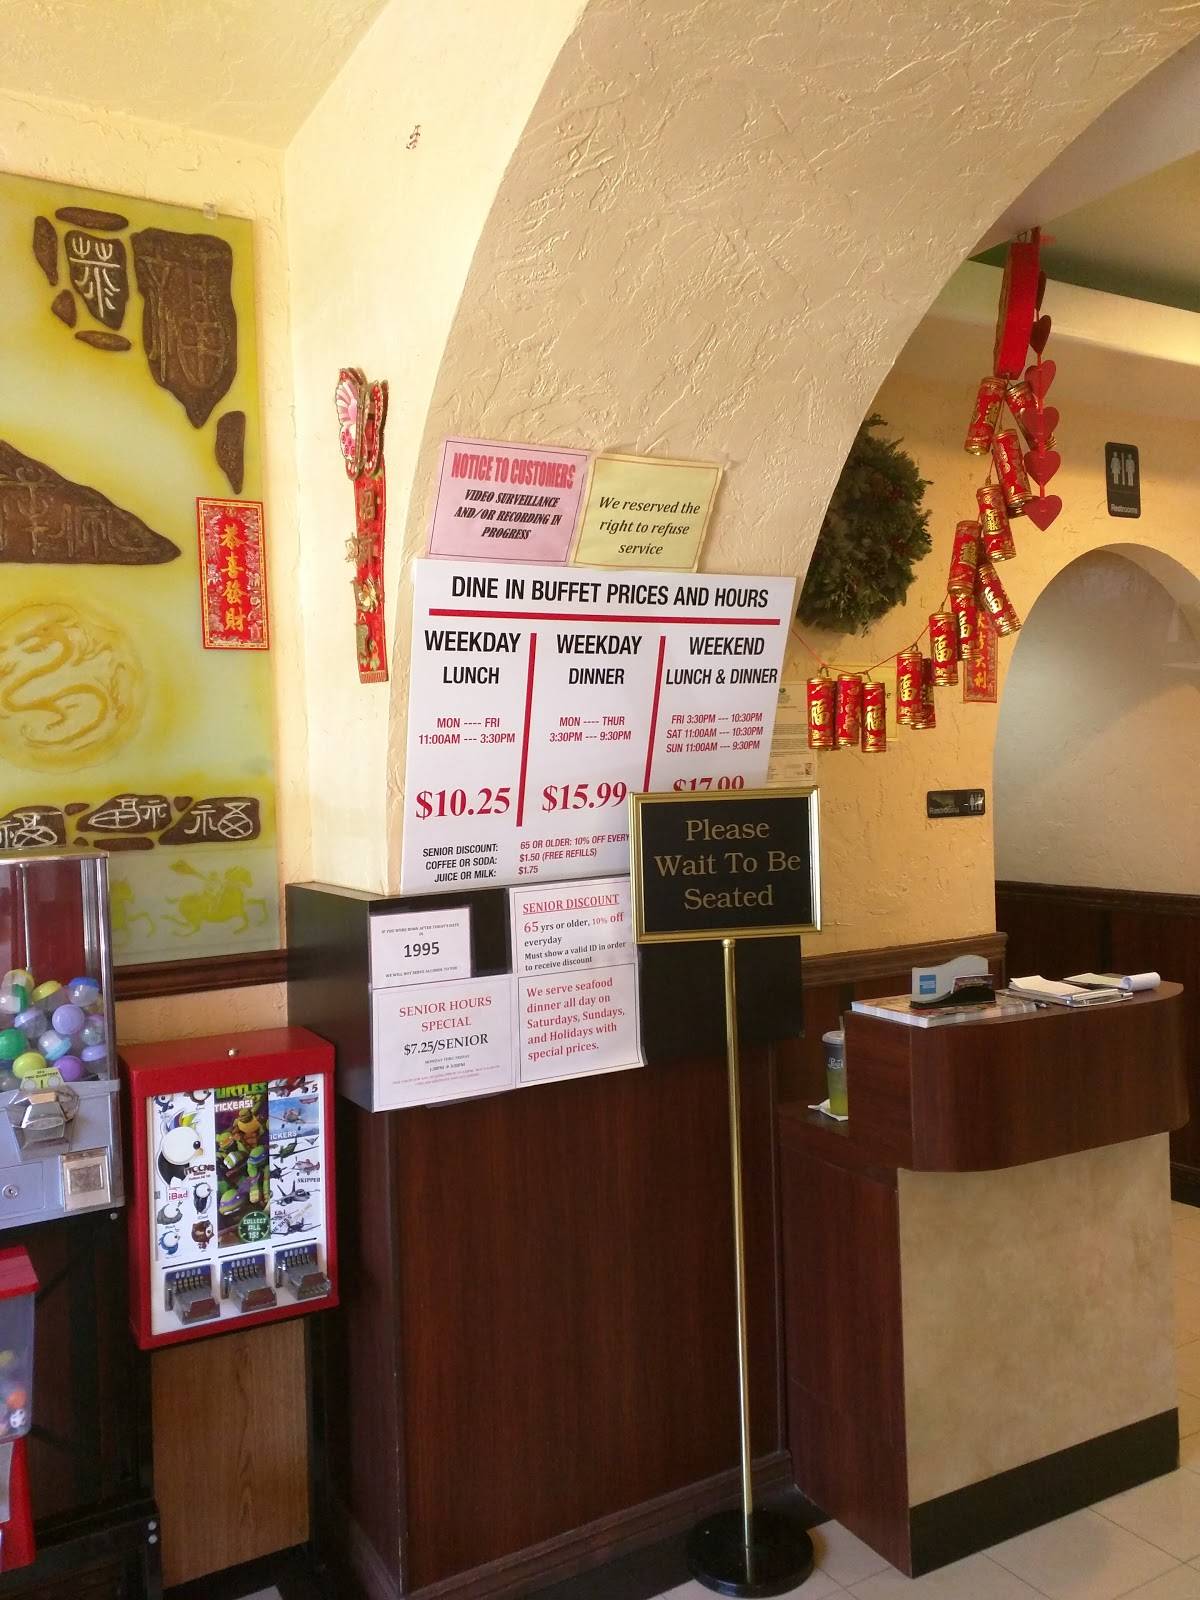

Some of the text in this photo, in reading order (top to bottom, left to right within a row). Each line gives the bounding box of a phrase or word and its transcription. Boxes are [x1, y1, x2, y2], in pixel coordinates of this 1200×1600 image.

[451, 452, 576, 489] NOTICE TO CUSTOMERS
[464, 489, 560, 508] VIDEO SURVEILLANCE
[598, 496, 701, 515] We reserved the
[454, 506, 562, 526] AND/OR RECORDING IN
[481, 526, 531, 540] PROGRESS
[599, 519, 690, 537] right to refuse
[618, 543, 664, 555] service
[452, 576, 768, 607] DINE IN BUFFET PRICES AND HOURS
[425, 630, 521, 652] WEEKDAY
[557, 634, 642, 654] WEEKDAY
[689, 637, 764, 655] WEEKEND
[443, 667, 499, 684] LUNCH
[569, 668, 624, 684] DINNER
[666, 669, 778, 684] LUNCH & DINNER
[437, 718, 499, 728] MON FRI
[559, 716, 625, 727] MON THUR
[671, 713, 763, 724] FRI 3:30PM 10:30PM
[419, 733, 515, 744] 11:00AM 3:30PM
[550, 731, 632, 742] 3:30PM 9:30PM
[666, 729, 682, 739] SAT
[684, 728, 717, 738] 11:00AM
[732, 727, 764, 736] 10:30PM
[666, 740, 760, 753] SUN 11:00AM 9:30PM
[416, 787, 510, 820] $10.25
[542, 781, 627, 813] $15.99
[685, 819, 770, 841] Please
[423, 843, 498, 857] SENIOR DISCOUNT:
[520, 841, 530, 850] 65
[532, 840, 543, 849] OR
[545, 838, 572, 848] OLDER:
[574, 836, 590, 845] 10%
[592, 835, 606, 844] OFF
[425, 857, 497, 870] COFFEE OR SODA:
[519, 848, 597, 863] $1.50 (FREE REFILLS)
[654, 851, 801, 877] Wait To Be
[434, 869, 497, 882] JUICE OR MILK:
[518, 866, 538, 875] $1.75
[523, 894, 620, 914] SENIOR DISCOUNT
[684, 884, 774, 910] Seated
[524, 921, 539, 933] 65
[540, 923, 554, 934] yrs
[567, 919, 590, 928] older,
[610, 912, 624, 923] off
[403, 941, 440, 958] 1995
[524, 936, 562, 947] everyday
[525, 952, 543, 961] Must
[544, 949, 564, 957] show
[570, 945, 588, 954] valid
[606, 941, 626, 949] order
[534, 961, 560, 970] receive
[562, 956, 592, 967] discount
[527, 977, 613, 998] We serve seafood
[400, 996, 492, 1017] SENIOR HOURS
[526, 994, 611, 1013] dinner all day on
[421, 1016, 472, 1032] SPECIAL
[527, 1007, 625, 1029] Saturdays, Sundays,
[528, 1022, 617, 1045] and Holidays with
[404, 1033, 489, 1056] $7.25/SENIOR
[528, 1042, 599, 1062] special prices.
[168, 1190, 188, 1201] iBad
